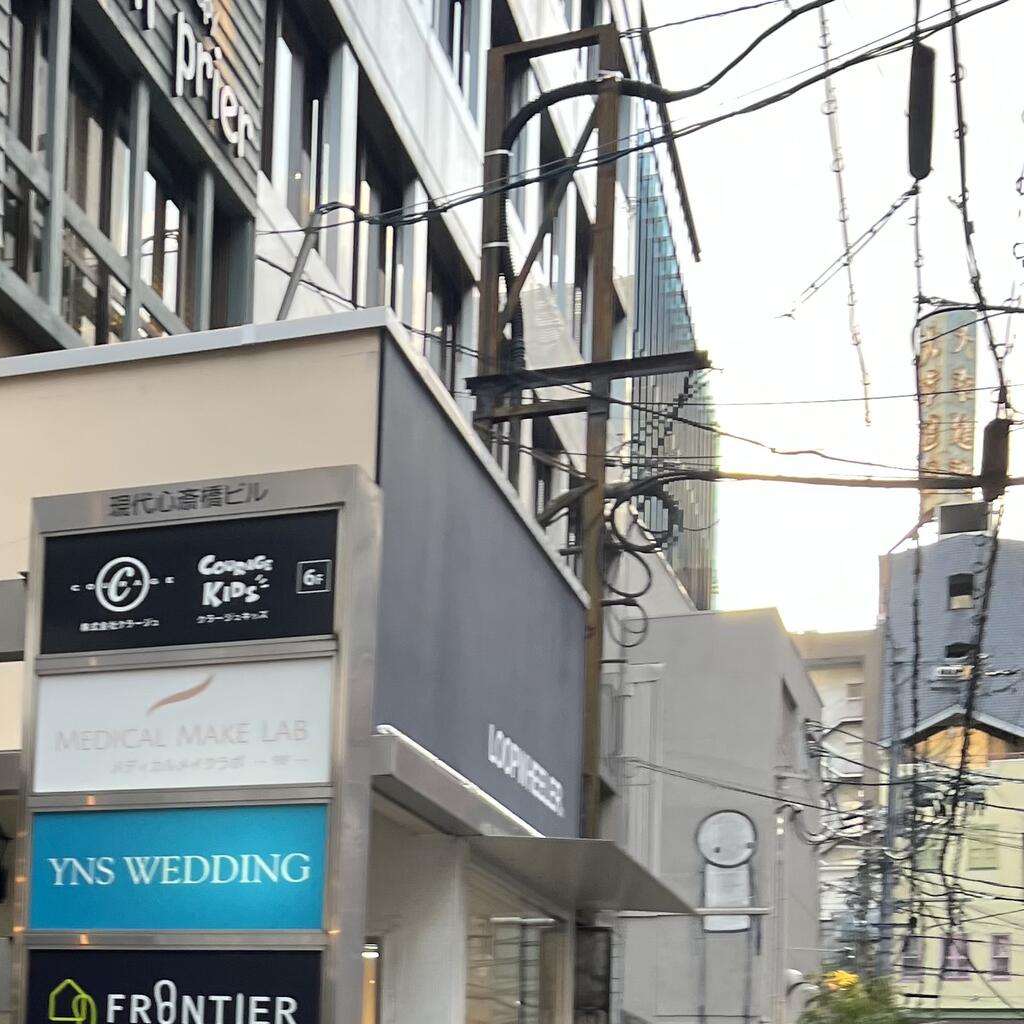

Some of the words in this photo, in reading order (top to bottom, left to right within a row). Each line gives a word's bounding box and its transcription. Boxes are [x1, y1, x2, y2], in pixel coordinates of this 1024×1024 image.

[301, 568, 325, 587] 6F
[202, 581, 261, 607] KIDS
[54, 726, 168, 752] MEDICAL
[176, 722, 251, 747] MAKE
[262, 718, 310, 743] LAB
[48, 856, 116, 886] YNS
[123, 852, 311, 885] WEDDING
